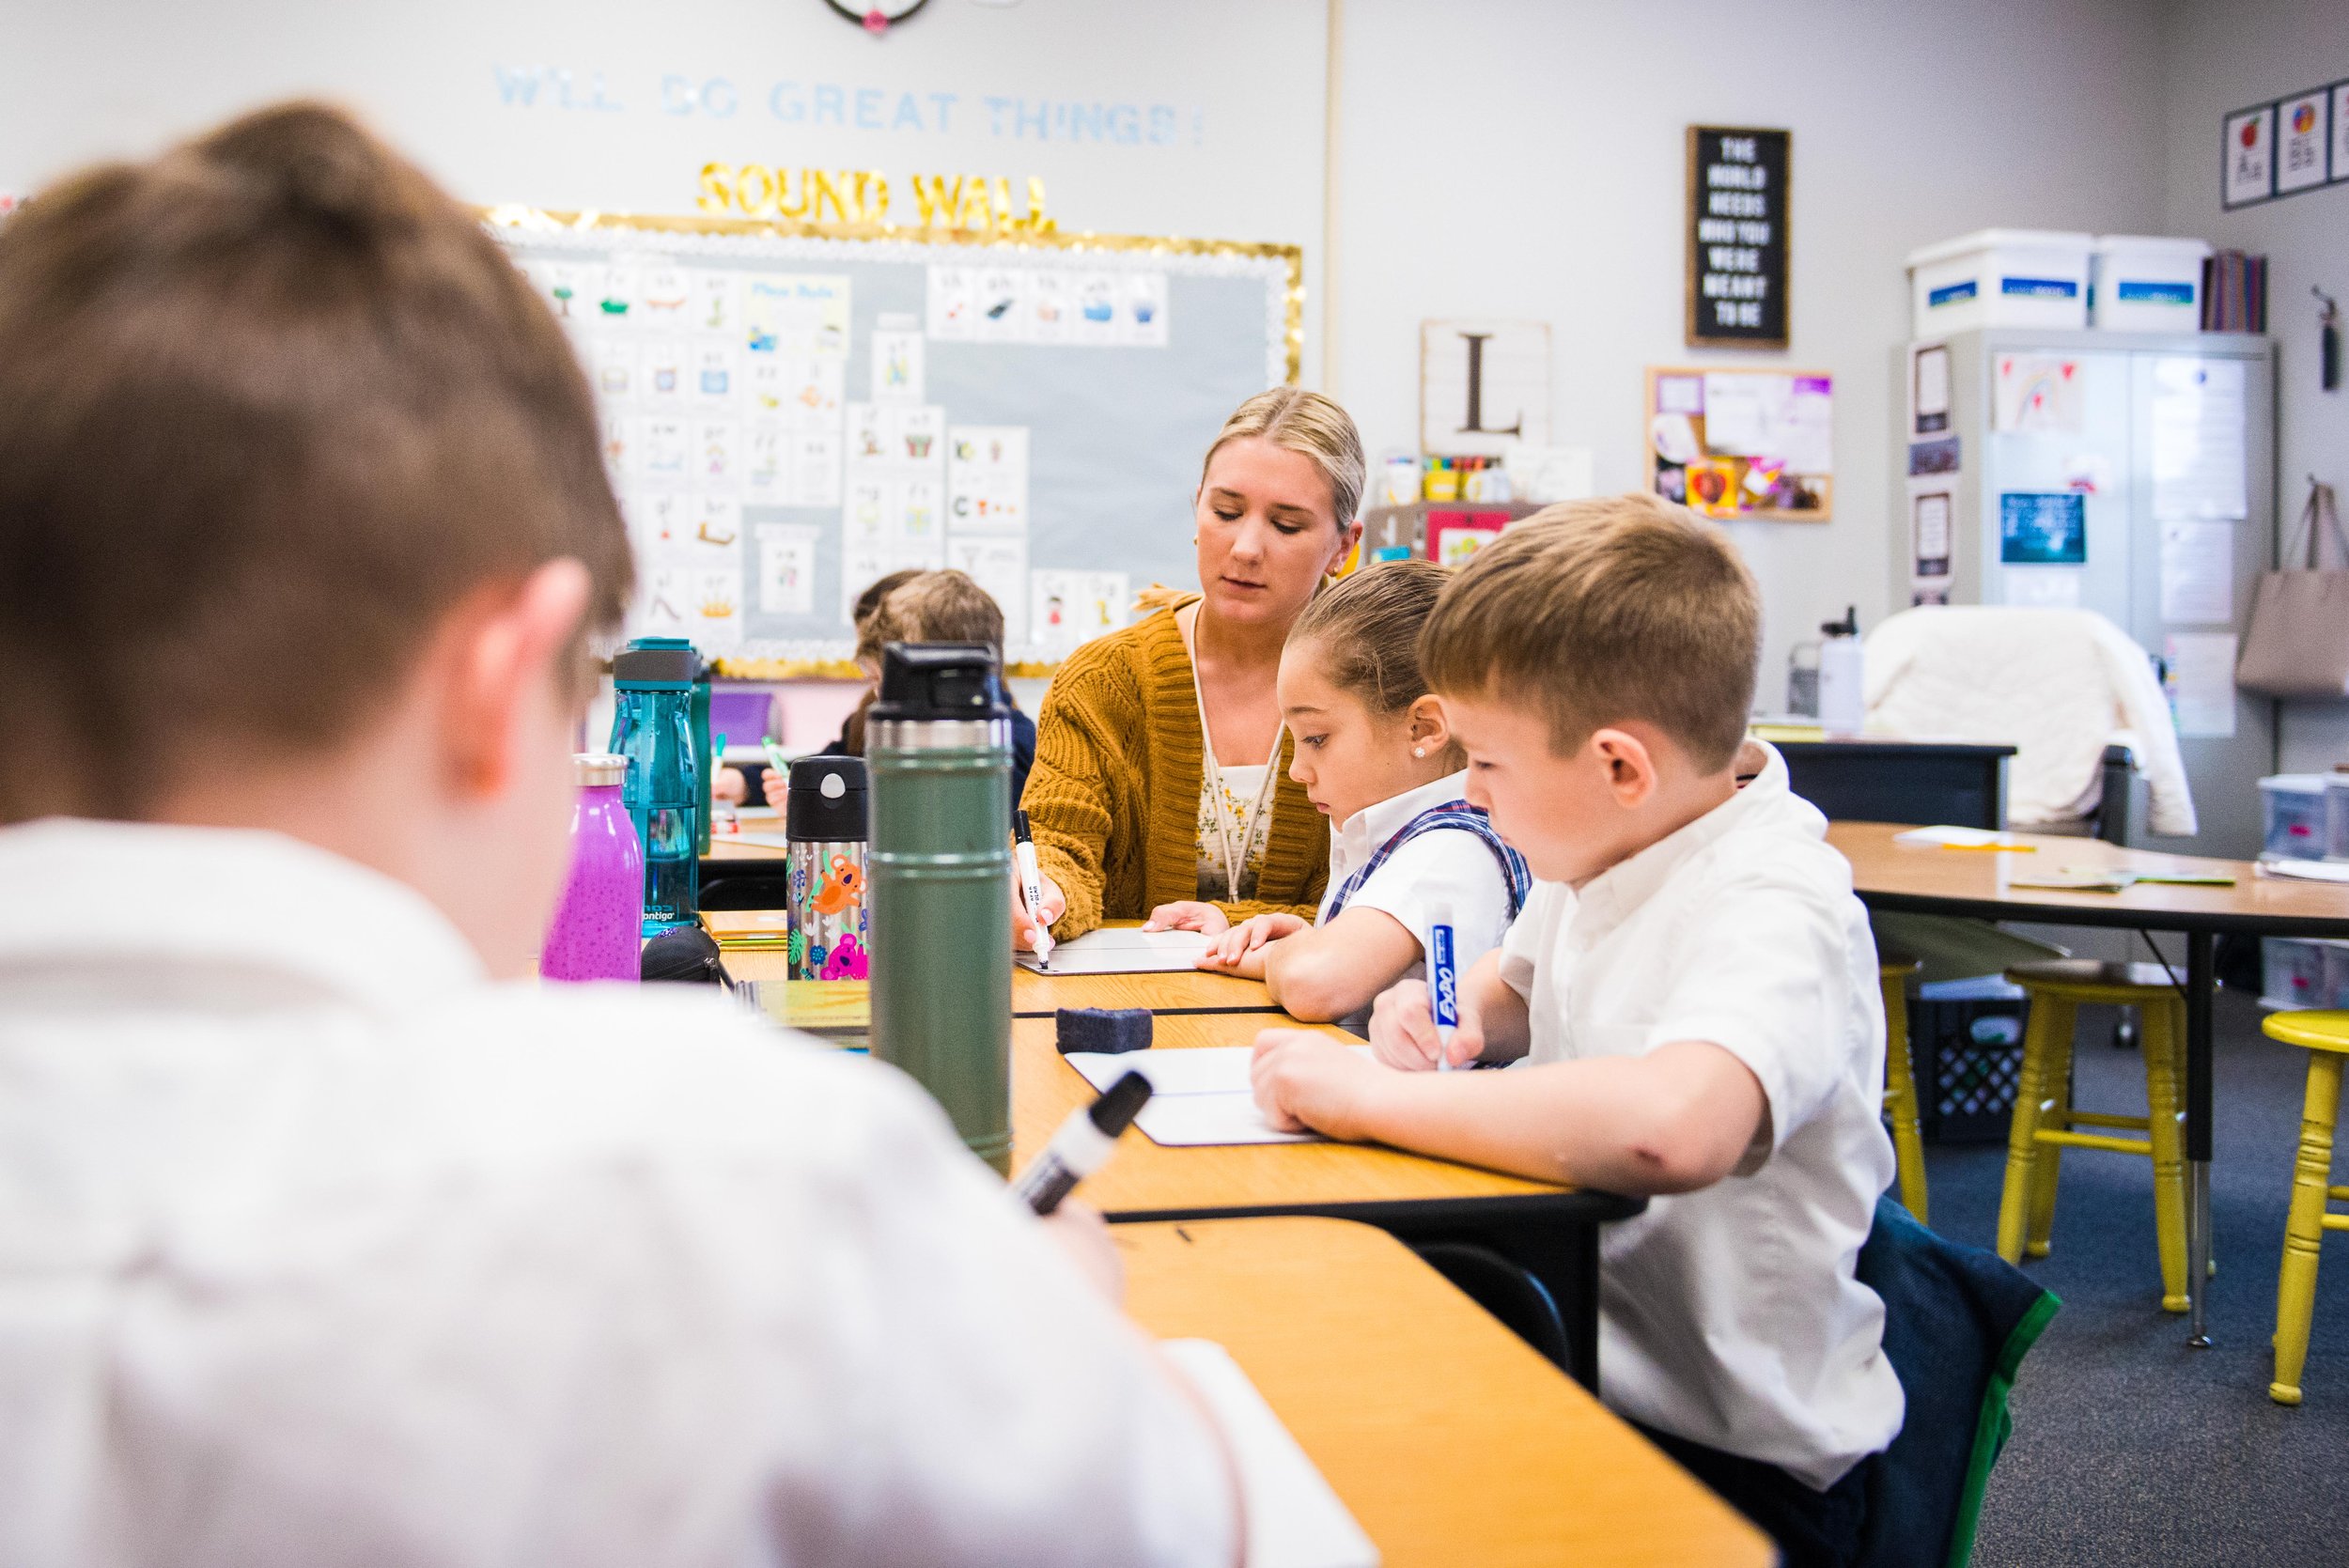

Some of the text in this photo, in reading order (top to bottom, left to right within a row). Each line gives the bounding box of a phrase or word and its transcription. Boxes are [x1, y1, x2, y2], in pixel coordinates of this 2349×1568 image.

[660, 72, 740, 120] DO
[767, 79, 961, 133] GREAT
[1720, 137, 1756, 163] THE
[695, 161, 1058, 233] SOUND WALL
[1455, 330, 1523, 441] L
[643, 911, 674, 921] ontigo
[1439, 967, 1455, 1022] EXPO
